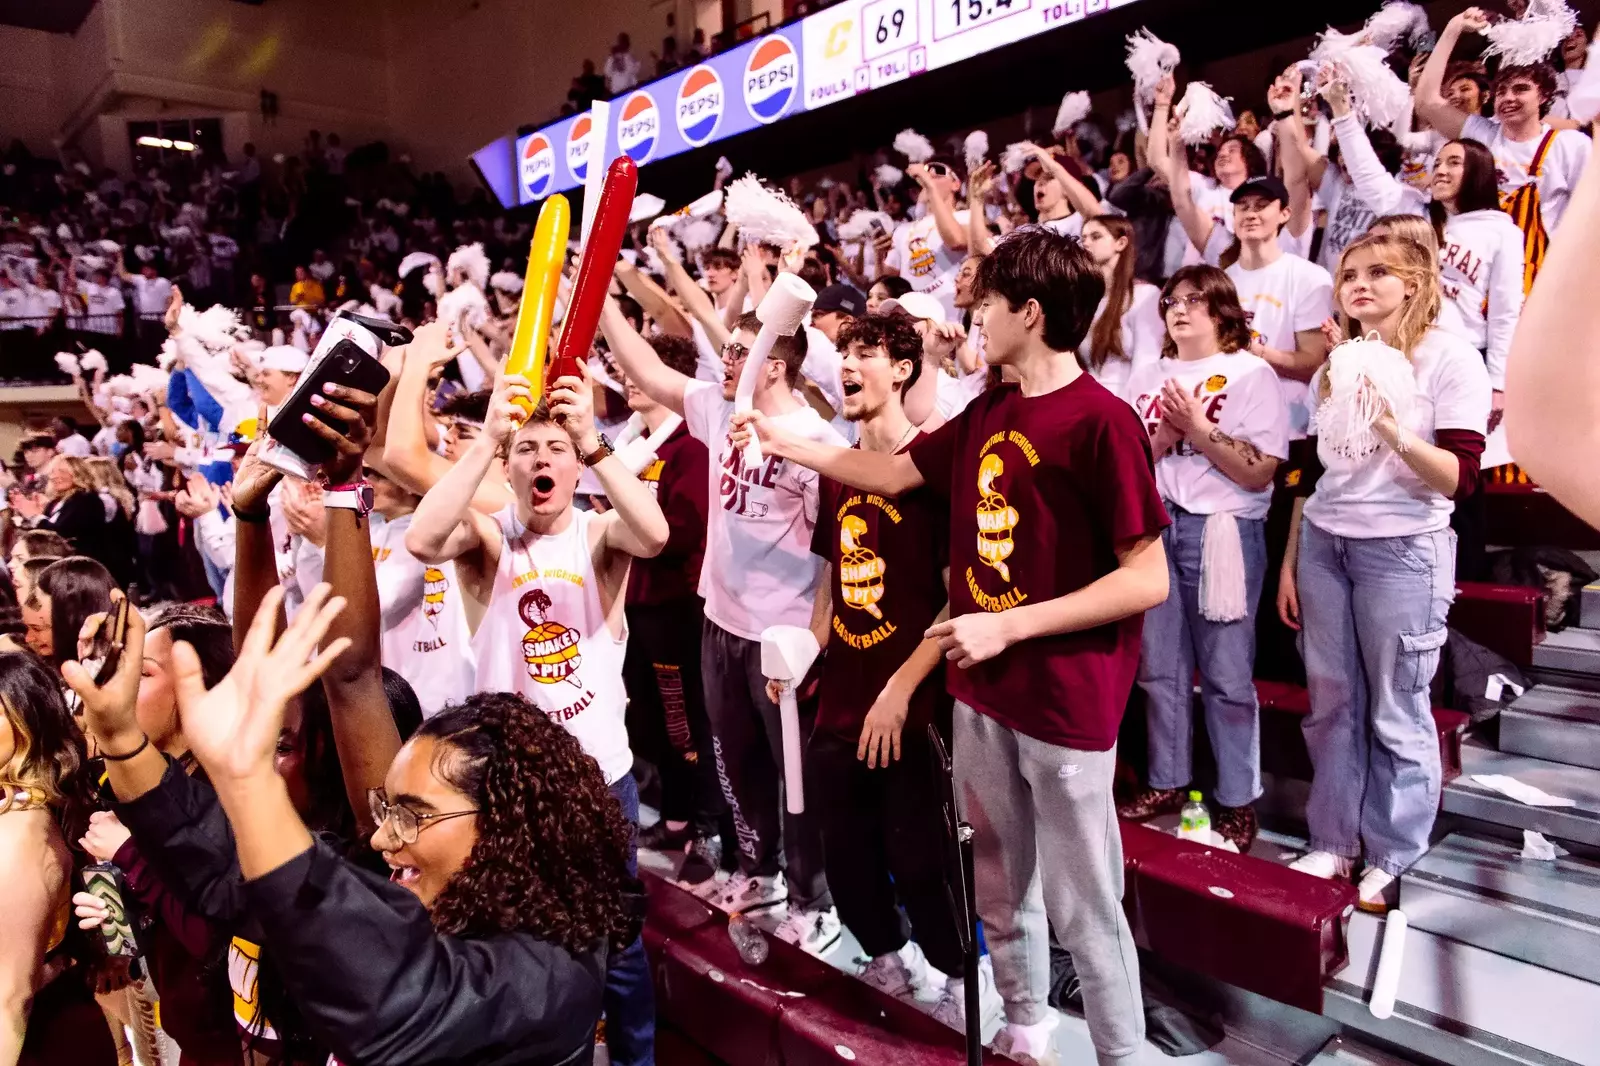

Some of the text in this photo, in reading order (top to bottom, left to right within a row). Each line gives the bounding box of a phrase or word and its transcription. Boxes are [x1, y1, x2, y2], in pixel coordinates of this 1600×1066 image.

[824, 19, 853, 59] C
[876, 9, 904, 44] 69
[748, 64, 794, 93] PEPSI
[681, 94, 720, 118] PEPSI
[622, 116, 656, 137] PEPSI
[571, 142, 589, 156] PEP
[1443, 242, 1481, 285] RAL
[1008, 429, 1041, 467] MICHIGAN
[866, 494, 903, 524] MICHIGAN
[842, 560, 877, 581] SNAKE
[966, 566, 1028, 613] BASKETBALL
[524, 632, 571, 657] SNAKE
[833, 614, 897, 650] BASKEBALL
[541, 660, 567, 678] PIT
